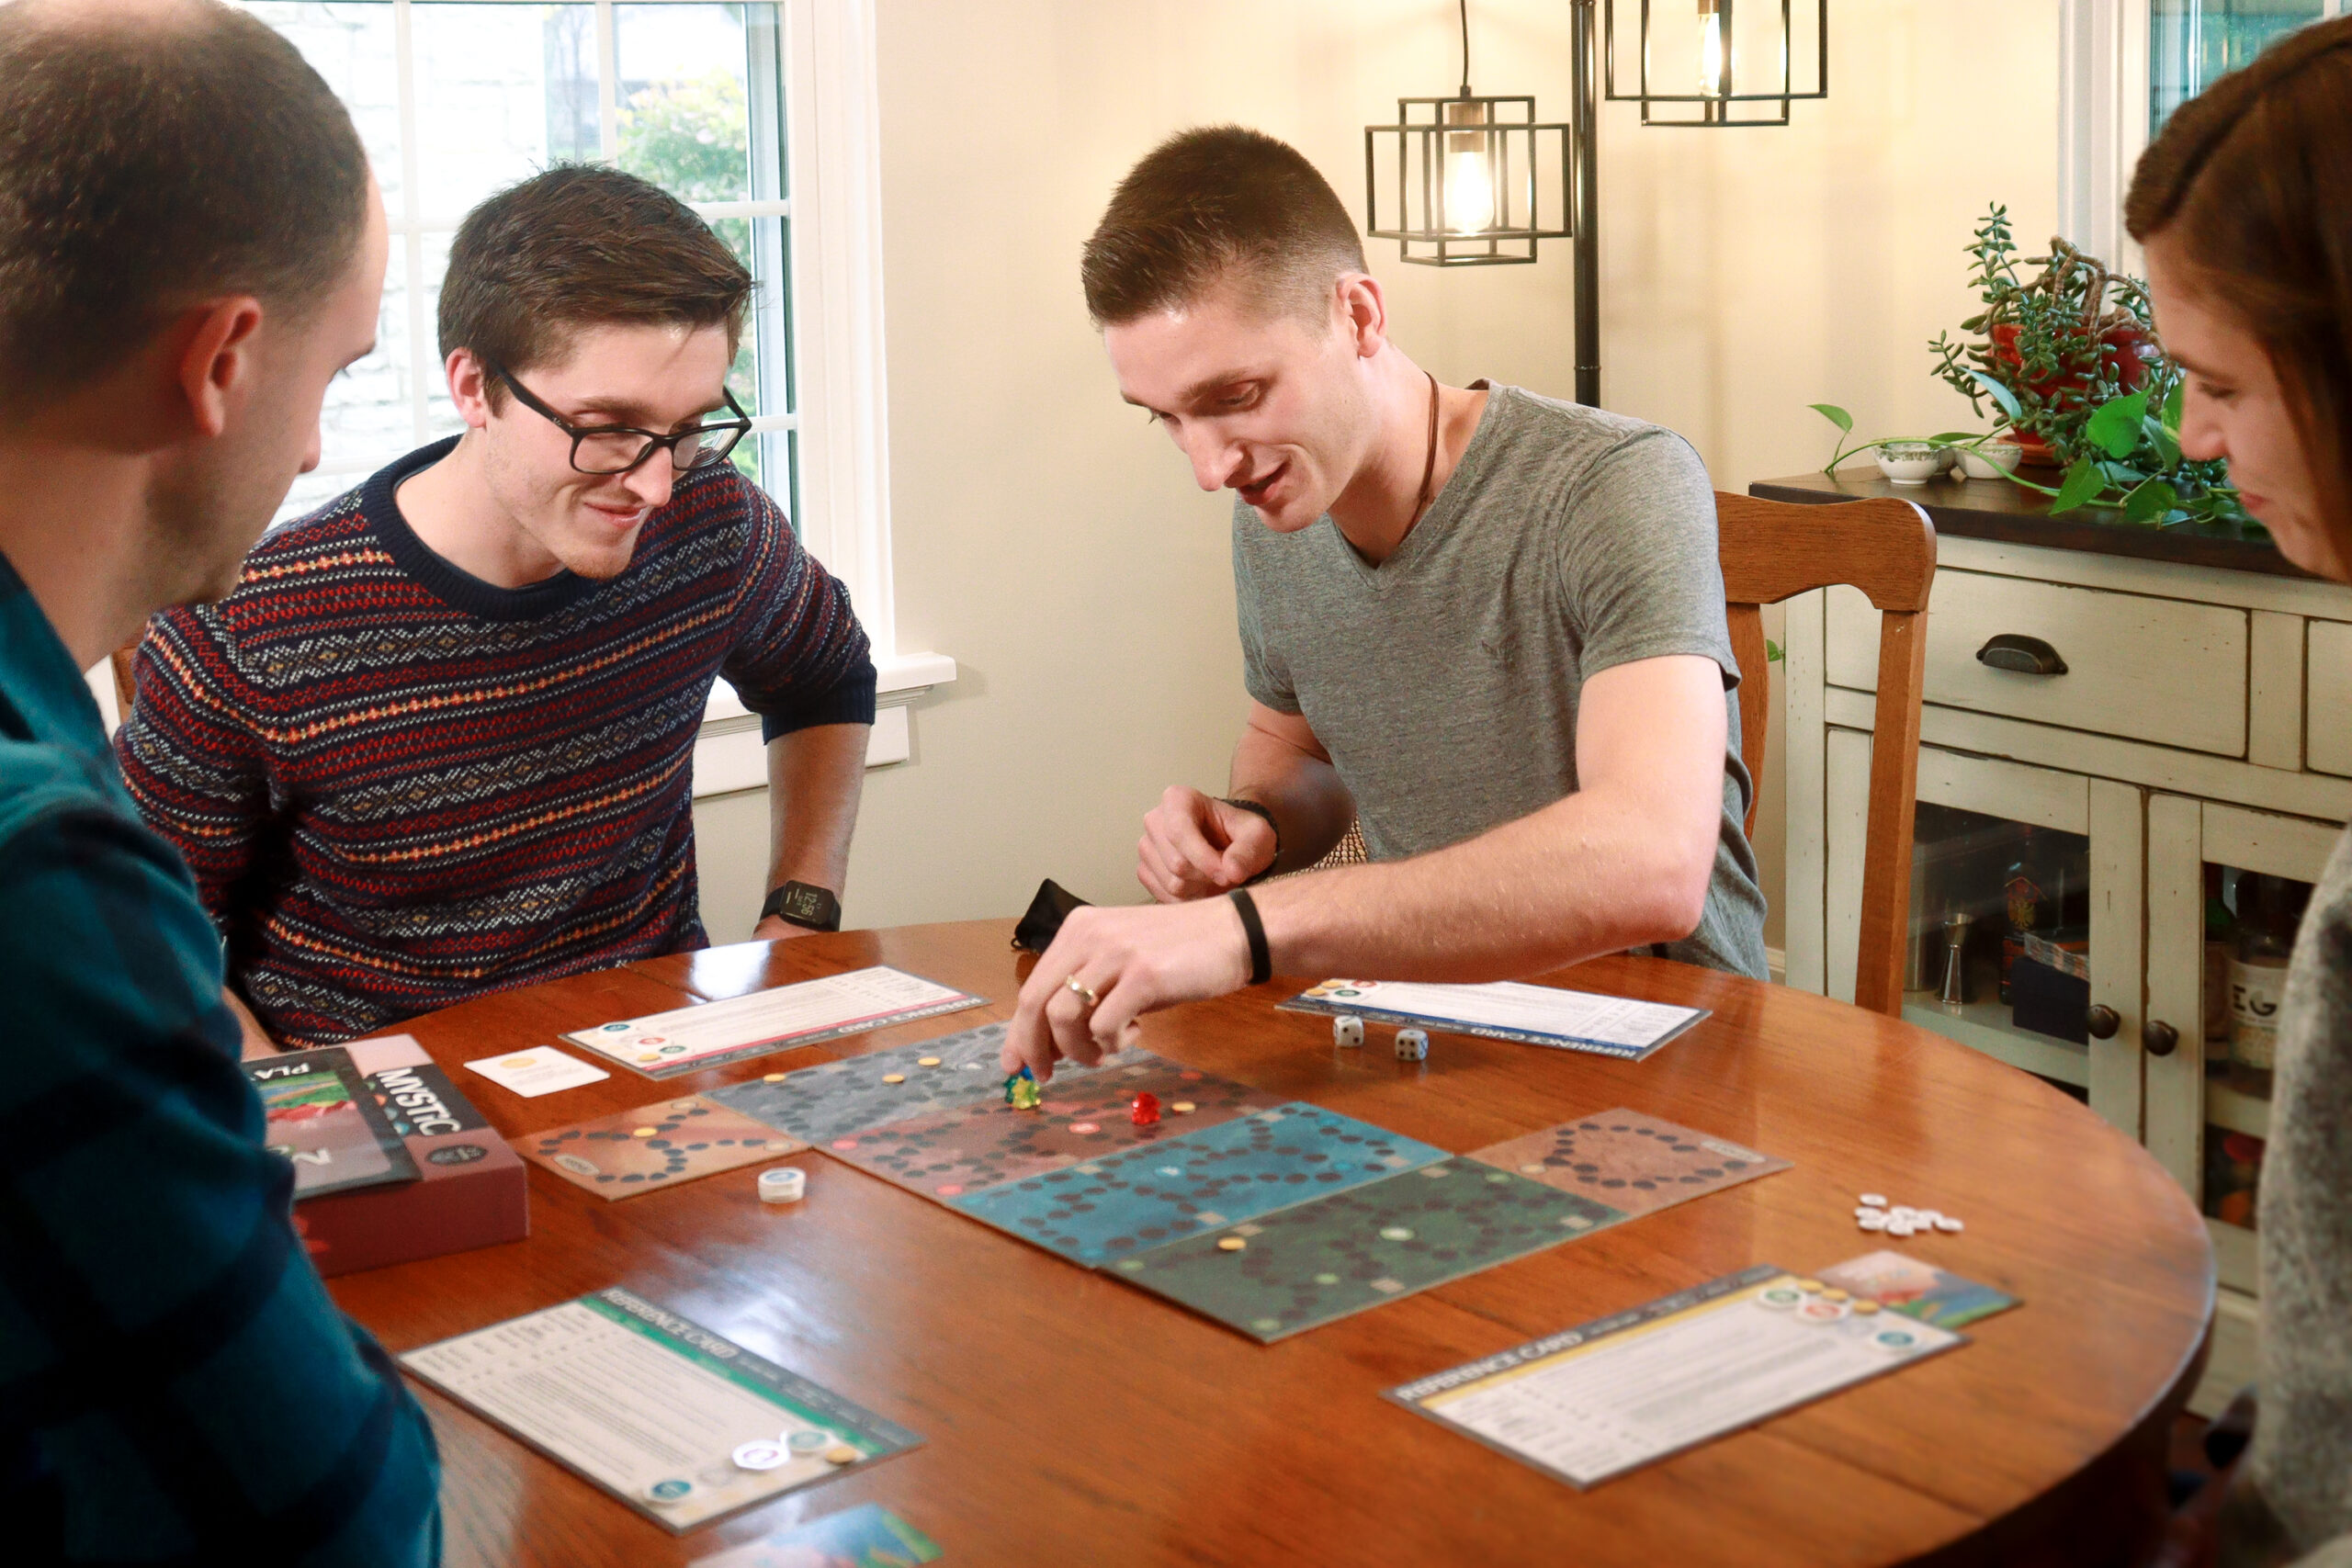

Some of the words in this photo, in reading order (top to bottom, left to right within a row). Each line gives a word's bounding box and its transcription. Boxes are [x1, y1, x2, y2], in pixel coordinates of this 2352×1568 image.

[1470, 1026, 1527, 1041] CARD
[1528, 1034, 1637, 1058] REFERENCE
[249, 1062, 310, 1082] PLA
[601, 1287, 690, 1336] REFERENCE
[684, 1333, 740, 1359] CARD
[1396, 1351, 1521, 1402] REFERENCE
[1518, 1331, 1583, 1360] CARD
